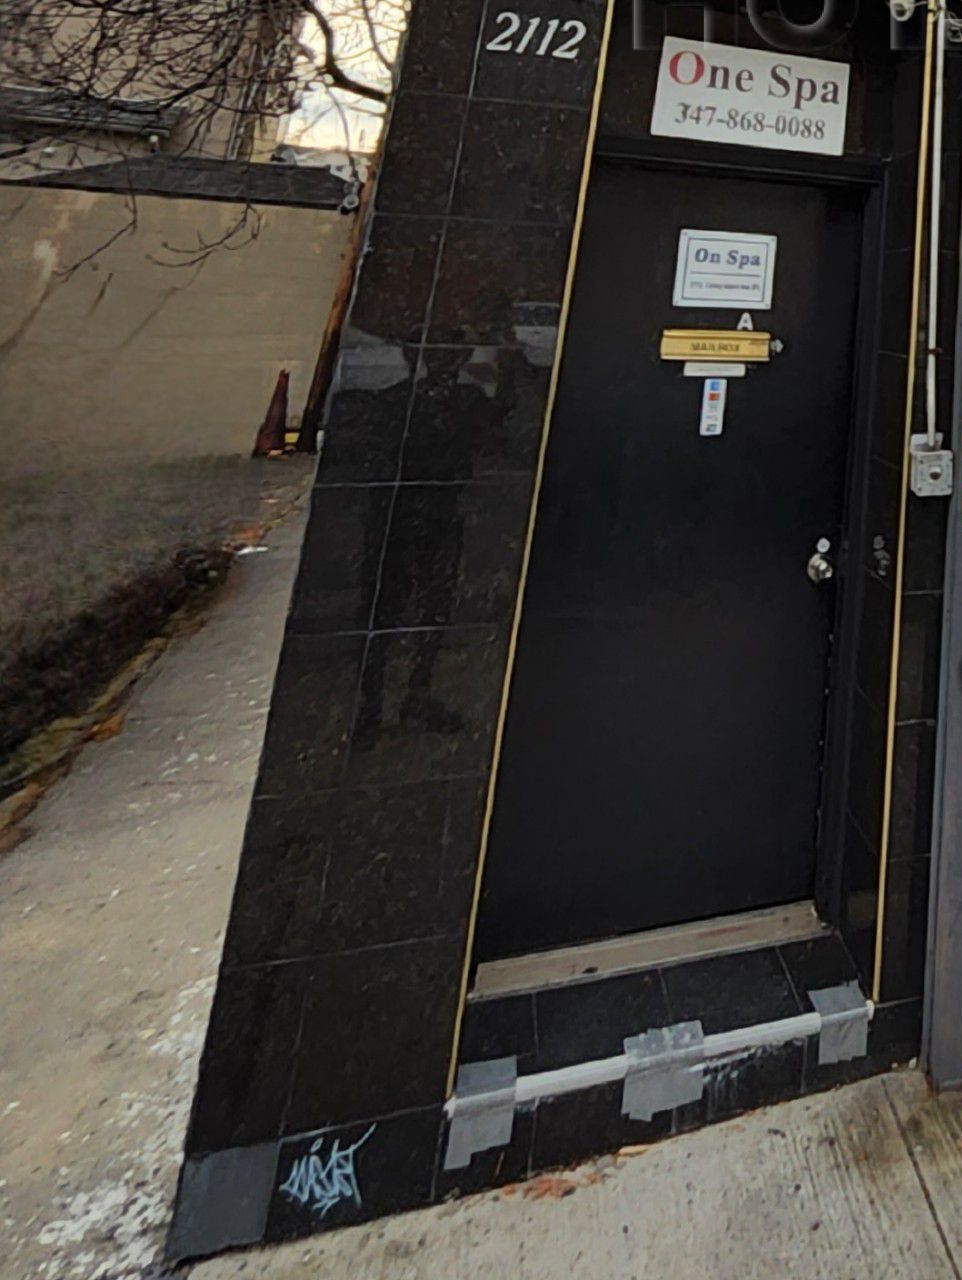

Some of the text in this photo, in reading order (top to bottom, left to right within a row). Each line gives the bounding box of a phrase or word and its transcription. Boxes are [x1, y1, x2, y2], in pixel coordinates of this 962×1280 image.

[486, 11, 588, 60] 2112
[668, 50, 841, 110] One Spa
[674, 101, 827, 141] 347-868-0088
[694, 247, 761, 269] On Spa
[736, 312, 754, 331] A
